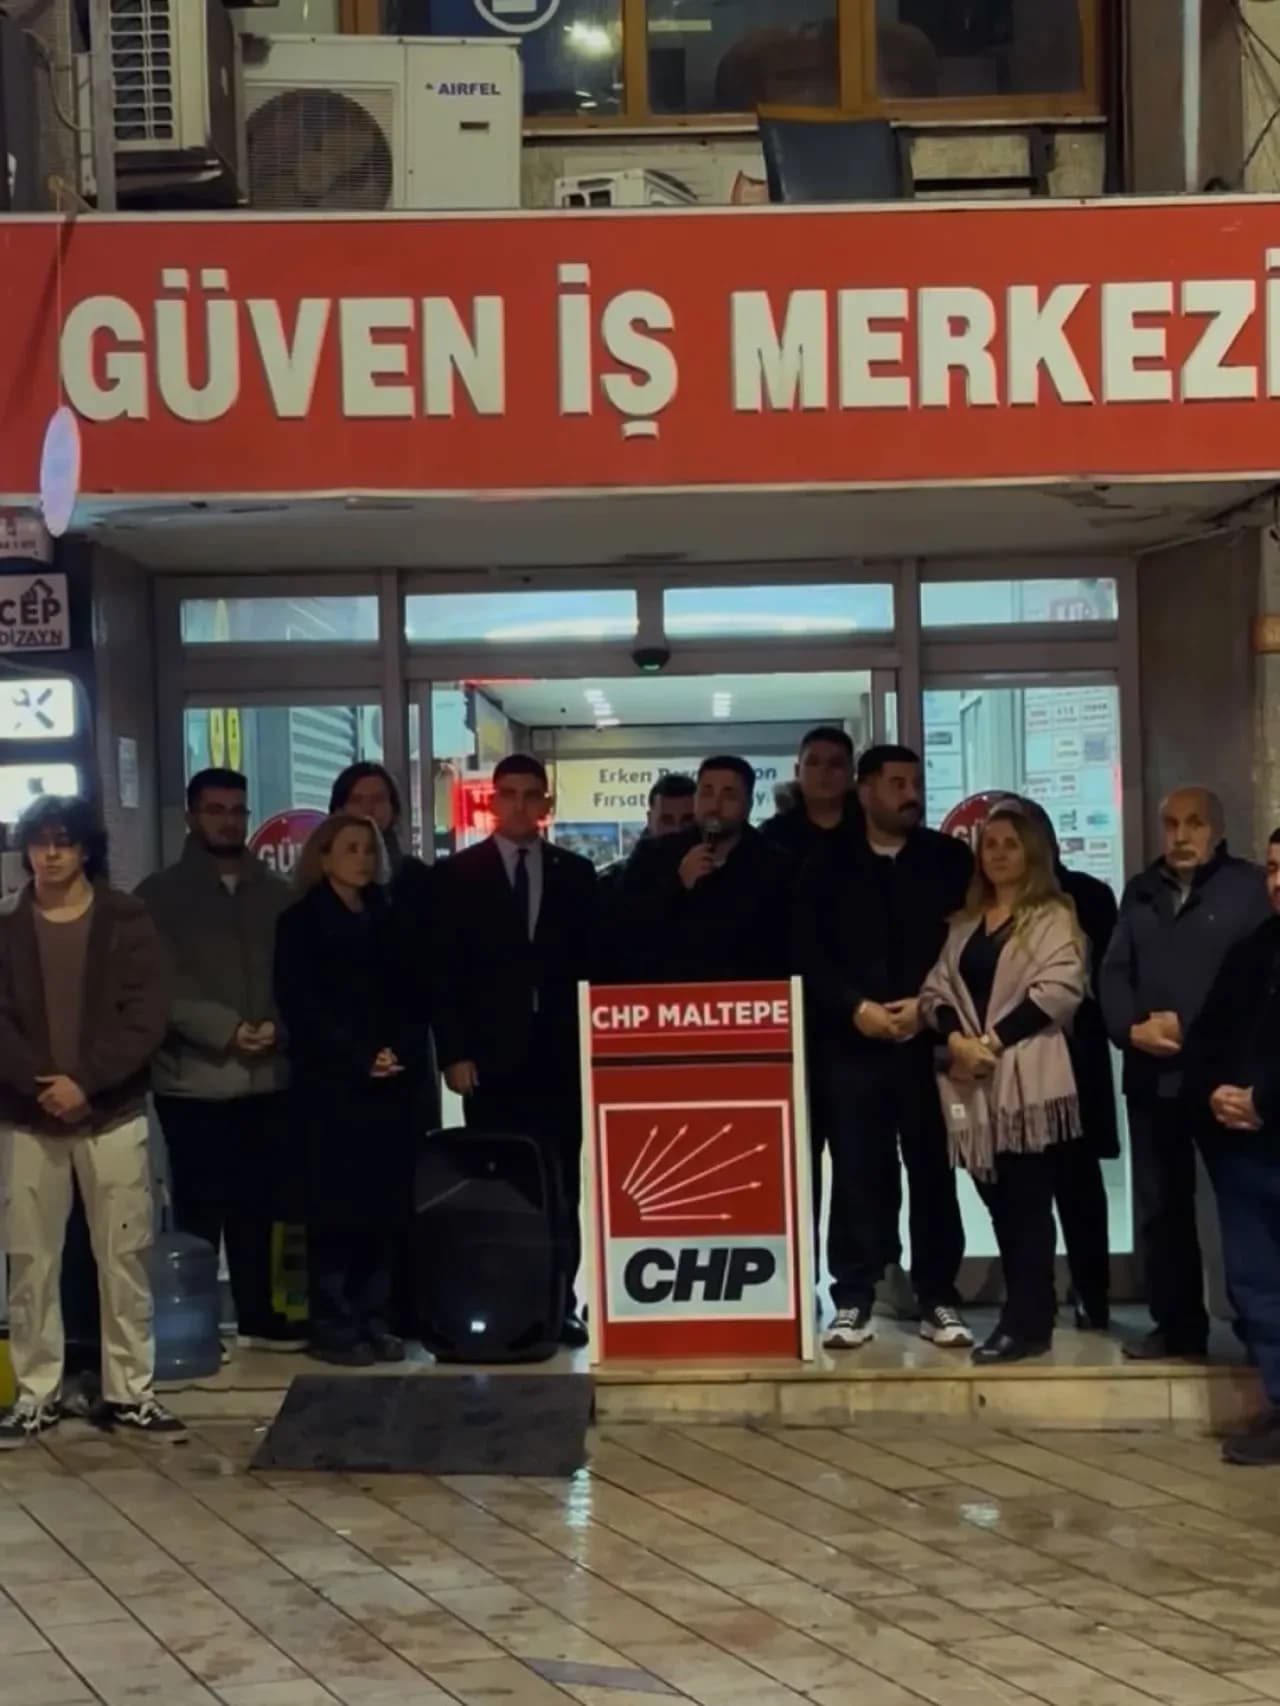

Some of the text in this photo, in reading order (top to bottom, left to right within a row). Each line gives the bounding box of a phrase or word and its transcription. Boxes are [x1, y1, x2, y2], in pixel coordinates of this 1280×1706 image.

[438, 82, 501, 96] AIRFEL
[60, 268, 505, 422] GÜVEN
[557, 263, 679, 439] İŞ
[0, 598, 62, 626] CEP
[0, 628, 62, 647] DİZAYN
[599, 768, 651, 784] Erken
[592, 1000, 789, 1029] CHP MALTEPE
[623, 1247, 776, 1304] CHP
